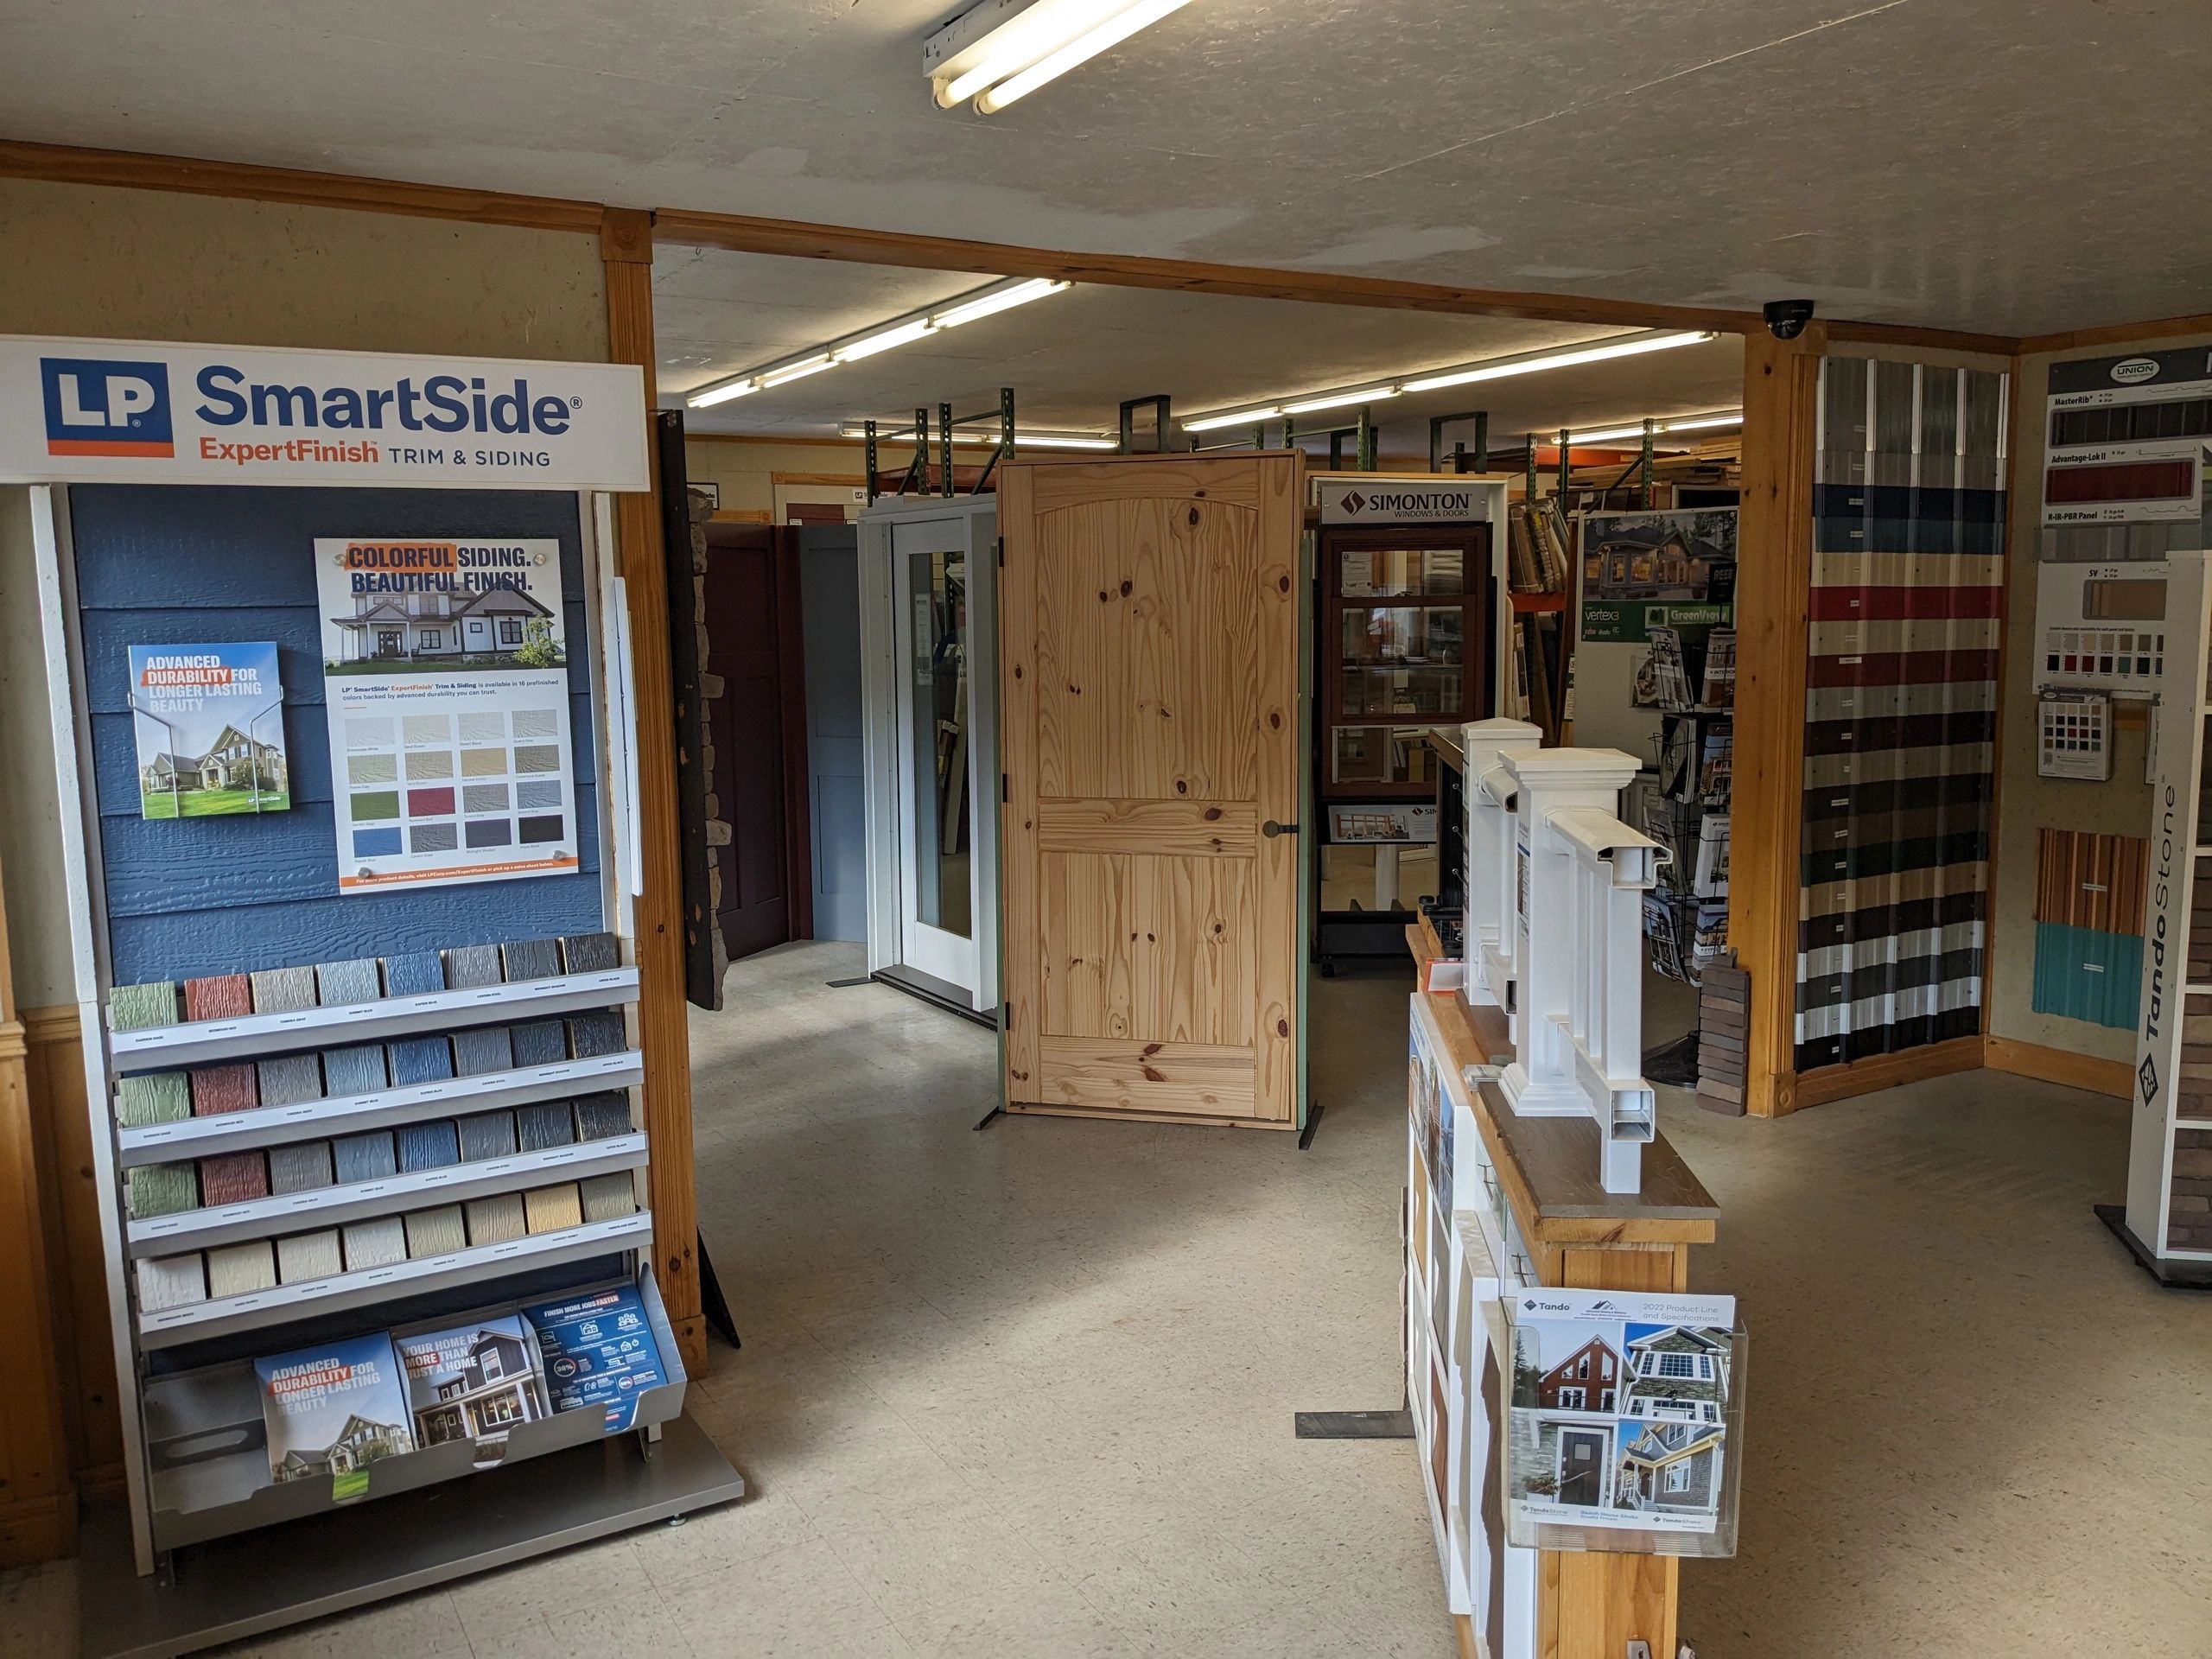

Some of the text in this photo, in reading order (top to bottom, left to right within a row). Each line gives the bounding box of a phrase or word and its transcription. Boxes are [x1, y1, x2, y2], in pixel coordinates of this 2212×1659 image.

[2117, 364, 2154, 375] UNION
[388, 447, 444, 466] TRIM
[454, 449, 467, 466] &
[474, 449, 550, 467] SIDING
[2051, 454, 2100, 464] Advantage-Lok
[1369, 493, 1469, 512] SIMONTON
[1394, 509, 1433, 518] WINDOWS
[2078, 512, 2098, 520] Panel
[348, 546, 531, 568] COLORFUL SIDING.
[351, 571, 533, 593] BEAUTIFUL FINISH.
[146, 655, 220, 670] ADVANCED
[148, 668, 257, 684] DURABILITY FOR
[149, 682, 262, 699] LONGER LASTING
[149, 699, 205, 713] BEAUTY
[2146, 784, 2175, 1038] TandoStone
[543, 1308, 564, 1318] FINISH
[564, 1304, 582, 1313] MORE
[582, 1300, 596, 1309] JOBS
[596, 1294, 620, 1306] FASTER
[1538, 1302, 1570, 1311] Tando
[1666, 1304, 1698, 1313] Product
[1661, 1313, 1719, 1322] Specifications
[404, 1333, 479, 1357] YOUR HOME IS
[405, 1346, 469, 1369] MORE THAN
[271, 1357, 340, 1381] ADVANCED
[273, 1361, 375, 1393] DURABILITY FOR
[408, 1356, 478, 1380] JUST A HOME
[275, 1372, 380, 1404] LONGER LASTING
[277, 1395, 327, 1416] BEAUTY
